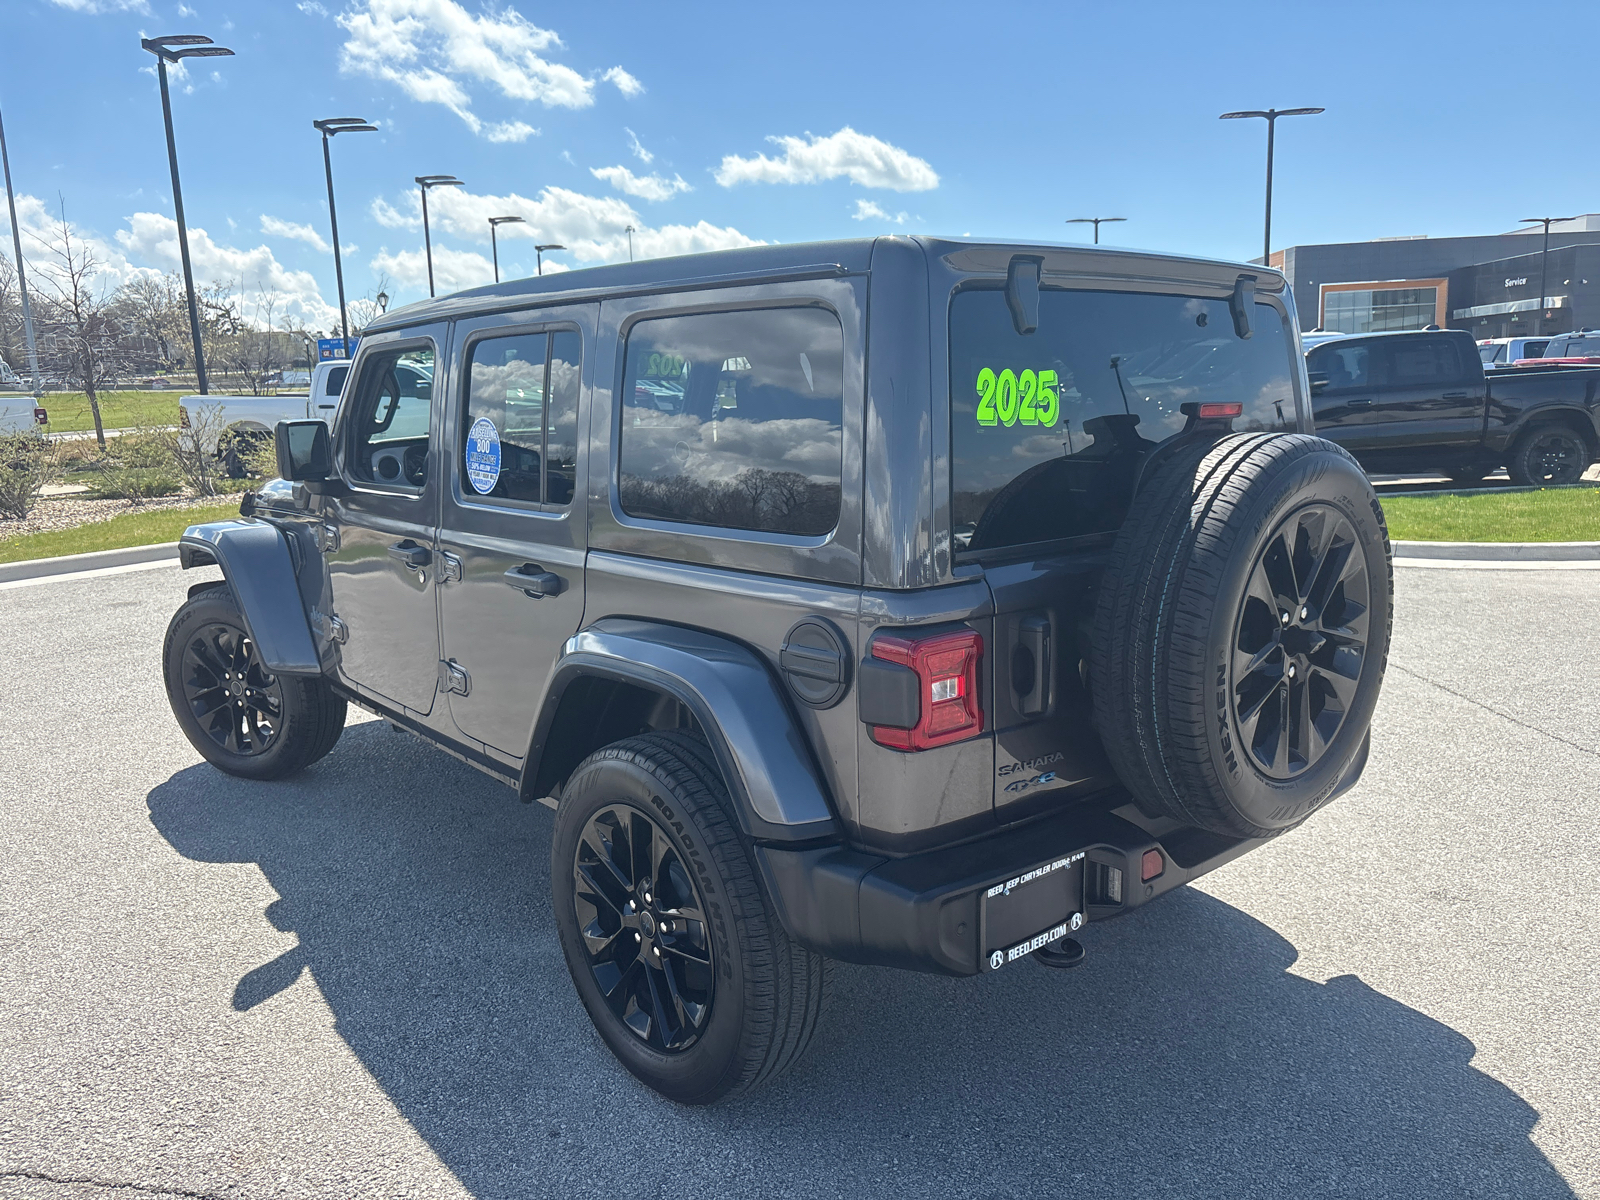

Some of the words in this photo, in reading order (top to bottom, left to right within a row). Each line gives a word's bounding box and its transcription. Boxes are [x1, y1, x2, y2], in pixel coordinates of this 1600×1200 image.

[1505, 277, 1527, 288] Service
[976, 367, 1060, 428] 2025
[1216, 663, 1238, 774] NEXEN
[998, 752, 1065, 777] SAHARA
[651, 795, 715, 894] ROADIAN
[709, 902, 733, 980] HTX2
[987, 884, 1004, 898] REED
[1005, 877, 1020, 890] JEEP
[1020, 864, 1051, 884] CHRYSLER
[1051, 857, 1071, 870] DODGE
[1008, 923, 1067, 962] REEDJEEP.COM
